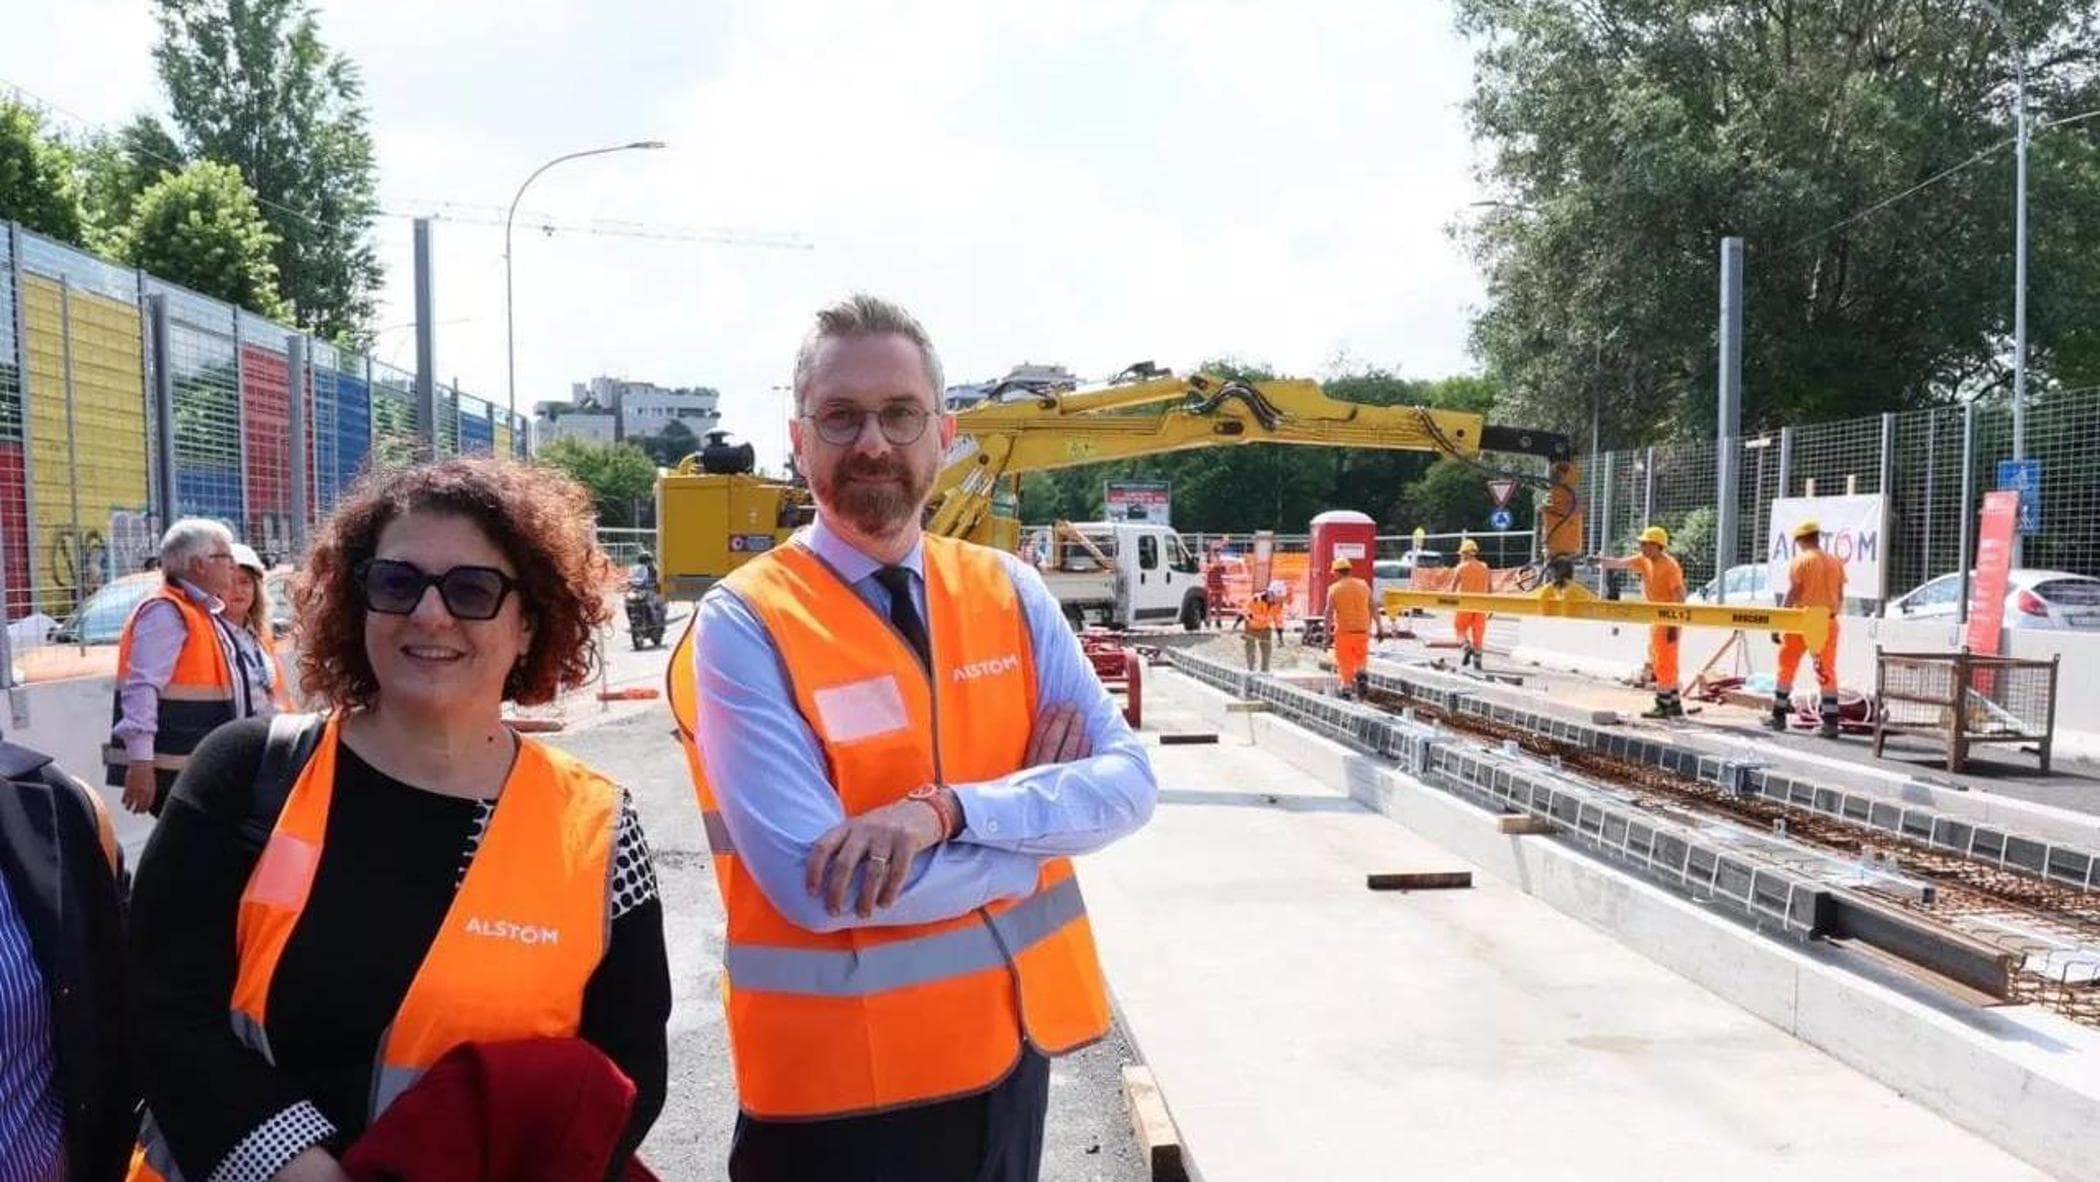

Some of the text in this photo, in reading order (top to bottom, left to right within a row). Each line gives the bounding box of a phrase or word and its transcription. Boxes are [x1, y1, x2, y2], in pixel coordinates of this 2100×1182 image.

[1773, 527, 1877, 563] ATOM
[953, 653, 1018, 682] ALSTOM
[465, 917, 559, 944] ALSTOM
